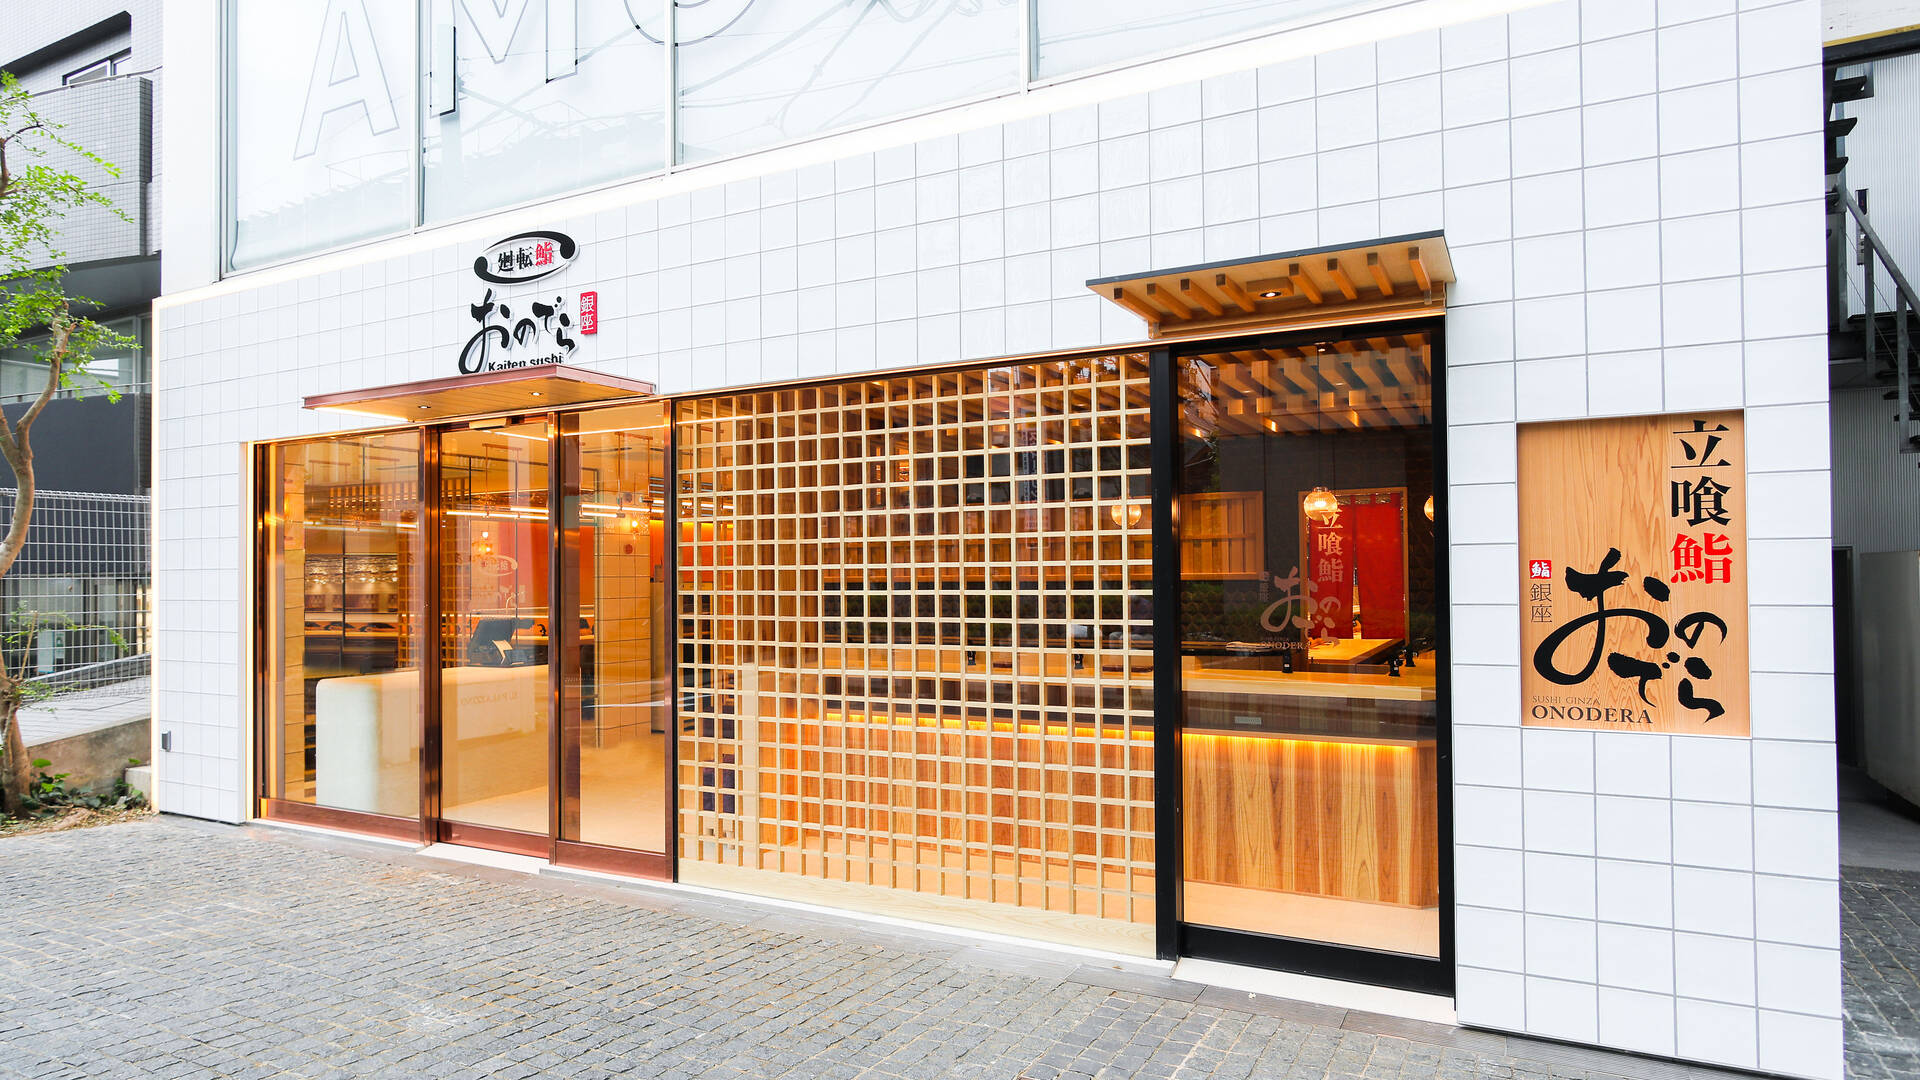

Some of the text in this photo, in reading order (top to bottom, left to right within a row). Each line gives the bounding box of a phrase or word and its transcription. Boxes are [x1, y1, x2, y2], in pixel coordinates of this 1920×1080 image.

[459, 288, 576, 375] おのでら
[581, 294, 594, 331] 銀座
[488, 352, 562, 372] Kaiten sushi
[1670, 420, 1733, 584] 立喰鮨
[1530, 561, 1552, 623] 鮨 銀座
[1533, 547, 1727, 724] おのでら
[1532, 696, 1600, 705] SUSHI GINZA
[1532, 705, 1653, 723] ONODERA
